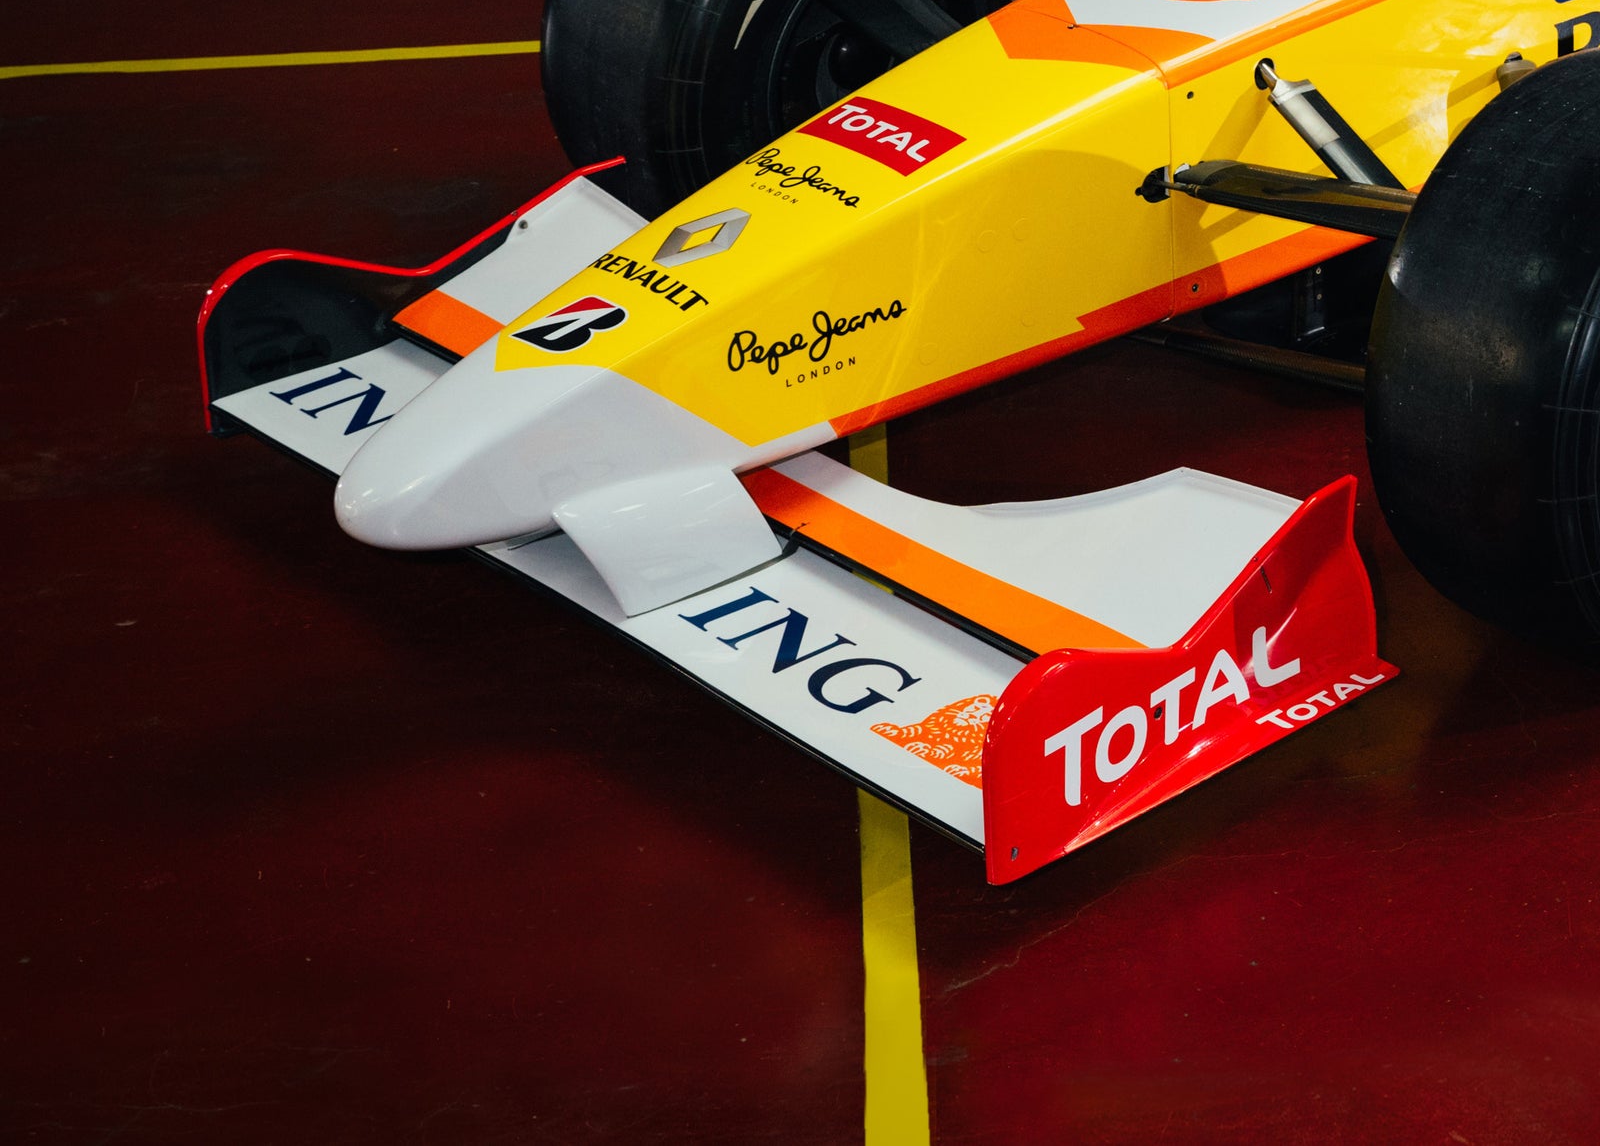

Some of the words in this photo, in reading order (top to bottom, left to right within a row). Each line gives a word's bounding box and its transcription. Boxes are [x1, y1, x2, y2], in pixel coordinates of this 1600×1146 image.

[828, 103, 930, 164] TOTAL
[746, 148, 795, 176] Pepe
[779, 166, 860, 208] Jeans
[750, 182, 799, 204] LONDON
[587, 253, 709, 312] RENAULT
[727, 330, 806, 375] Pepe
[808, 299, 907, 361] Jeans
[269, 367, 396, 436] IN
[785, 356, 857, 388] LONDON
[678, 585, 921, 715] ING
[1043, 625, 1301, 806] TOTAL
[1256, 668, 1386, 730] TOTAL
